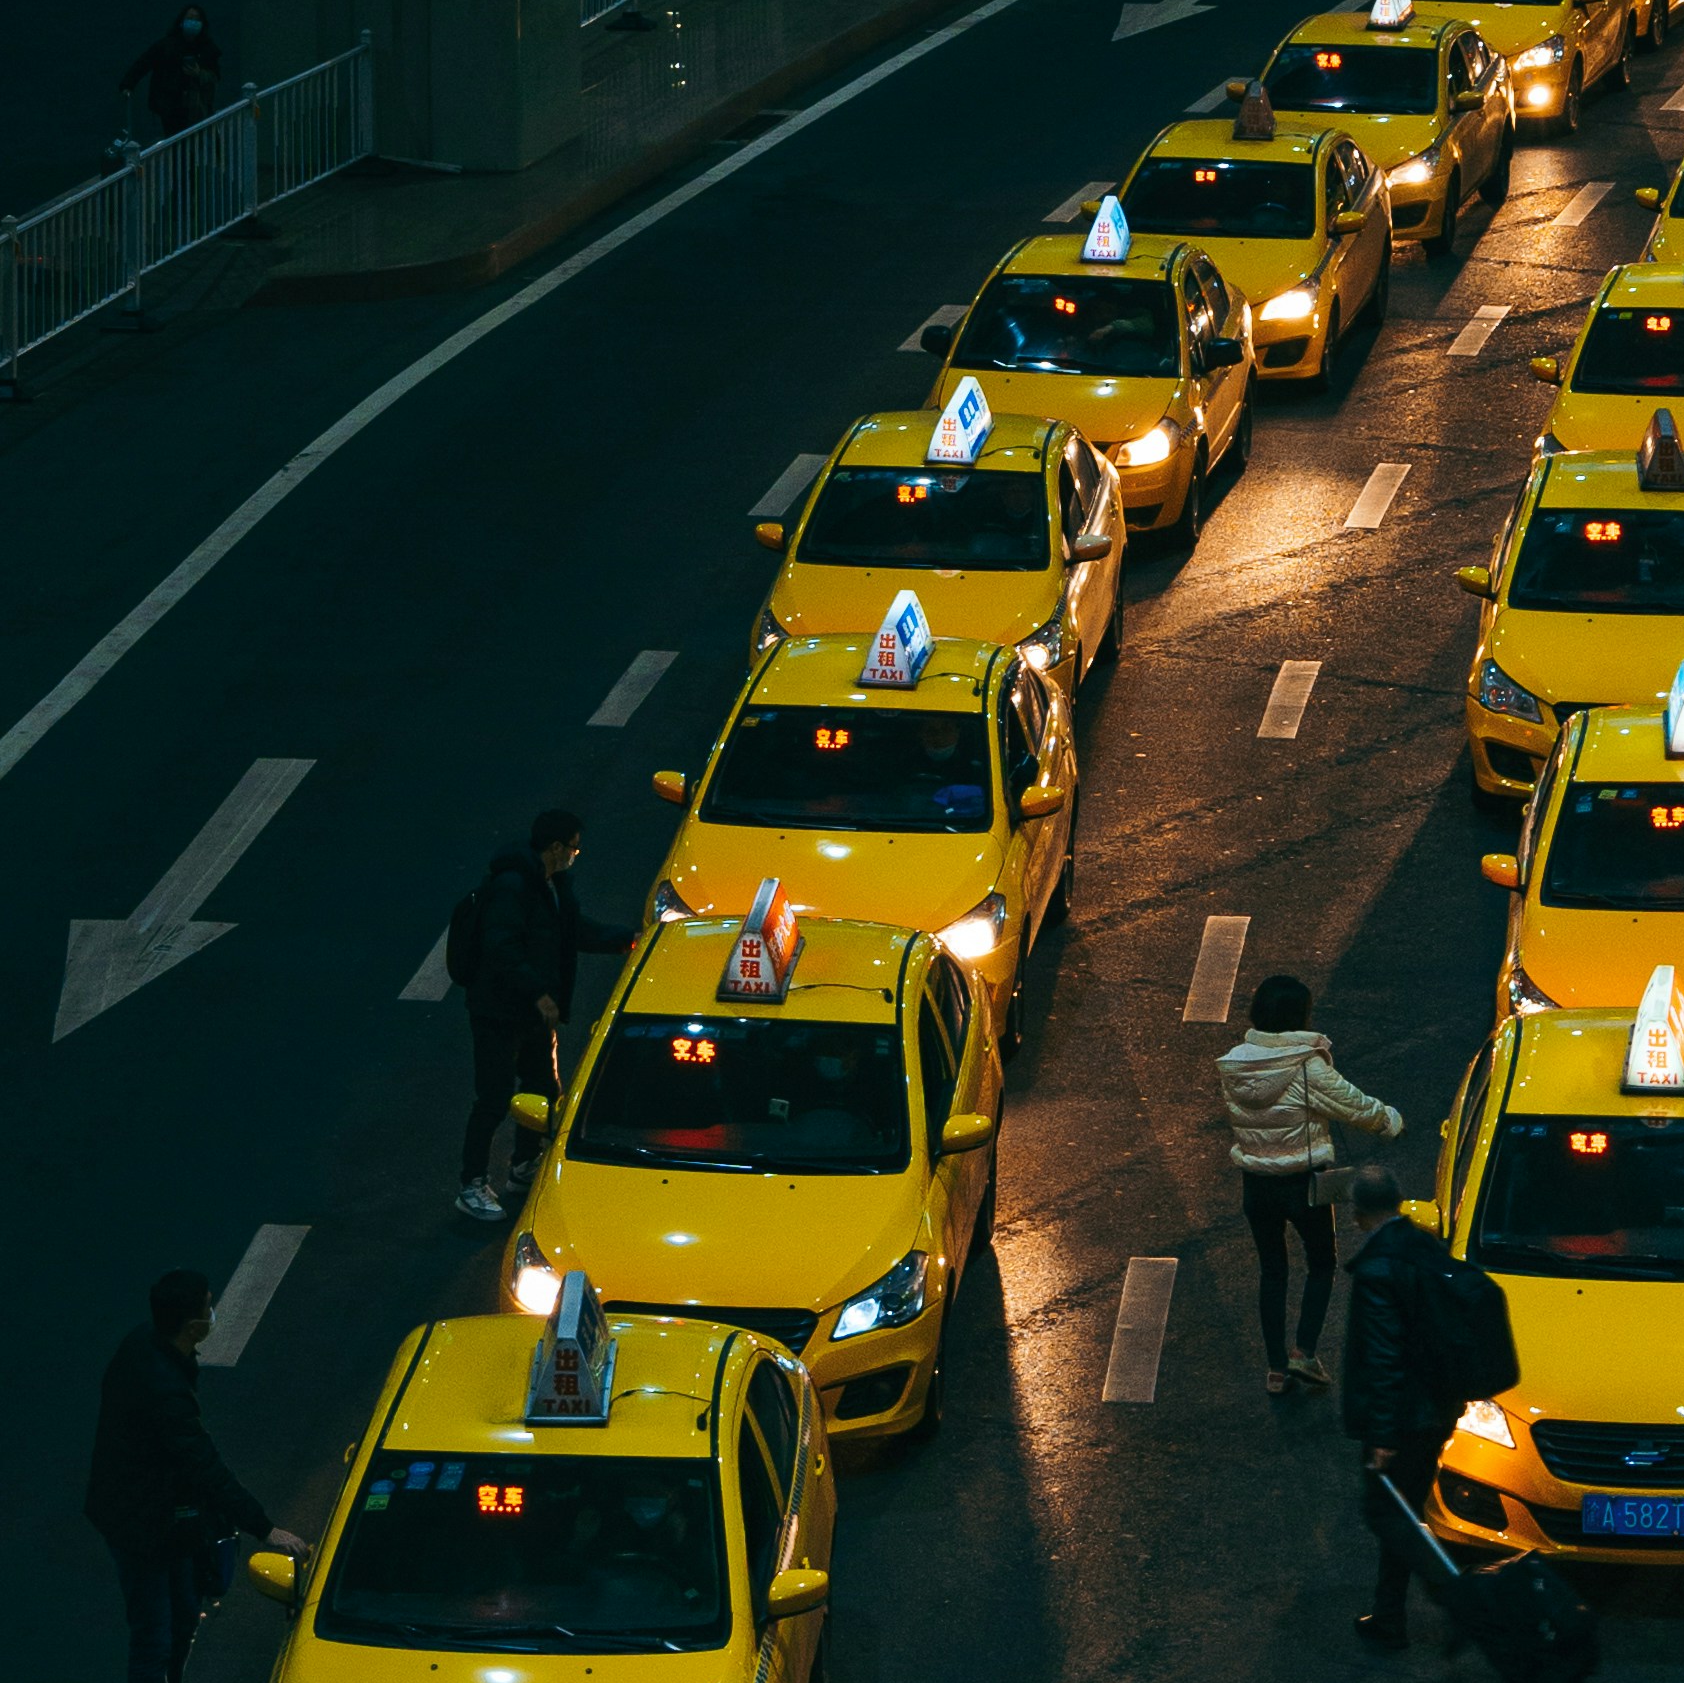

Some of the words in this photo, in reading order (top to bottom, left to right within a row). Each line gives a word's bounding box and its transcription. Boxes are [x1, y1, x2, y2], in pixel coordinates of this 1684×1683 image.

[1091, 249, 1117, 258] TAXI
[943, 418, 957, 446] 出租
[935, 449, 963, 458] TAXI
[878, 633, 896, 667] 出租
[870, 668, 904, 681] TAXI
[740, 939, 761, 979] 出租
[730, 980, 770, 994] TAXI
[1648, 1028, 1668, 1069] 出租
[1637, 1073, 1679, 1085] TAXI
[555, 1349, 580, 1396] 出租
[543, 1399, 591, 1414] TAXI
[477, 1485, 524, 1513] 空车
